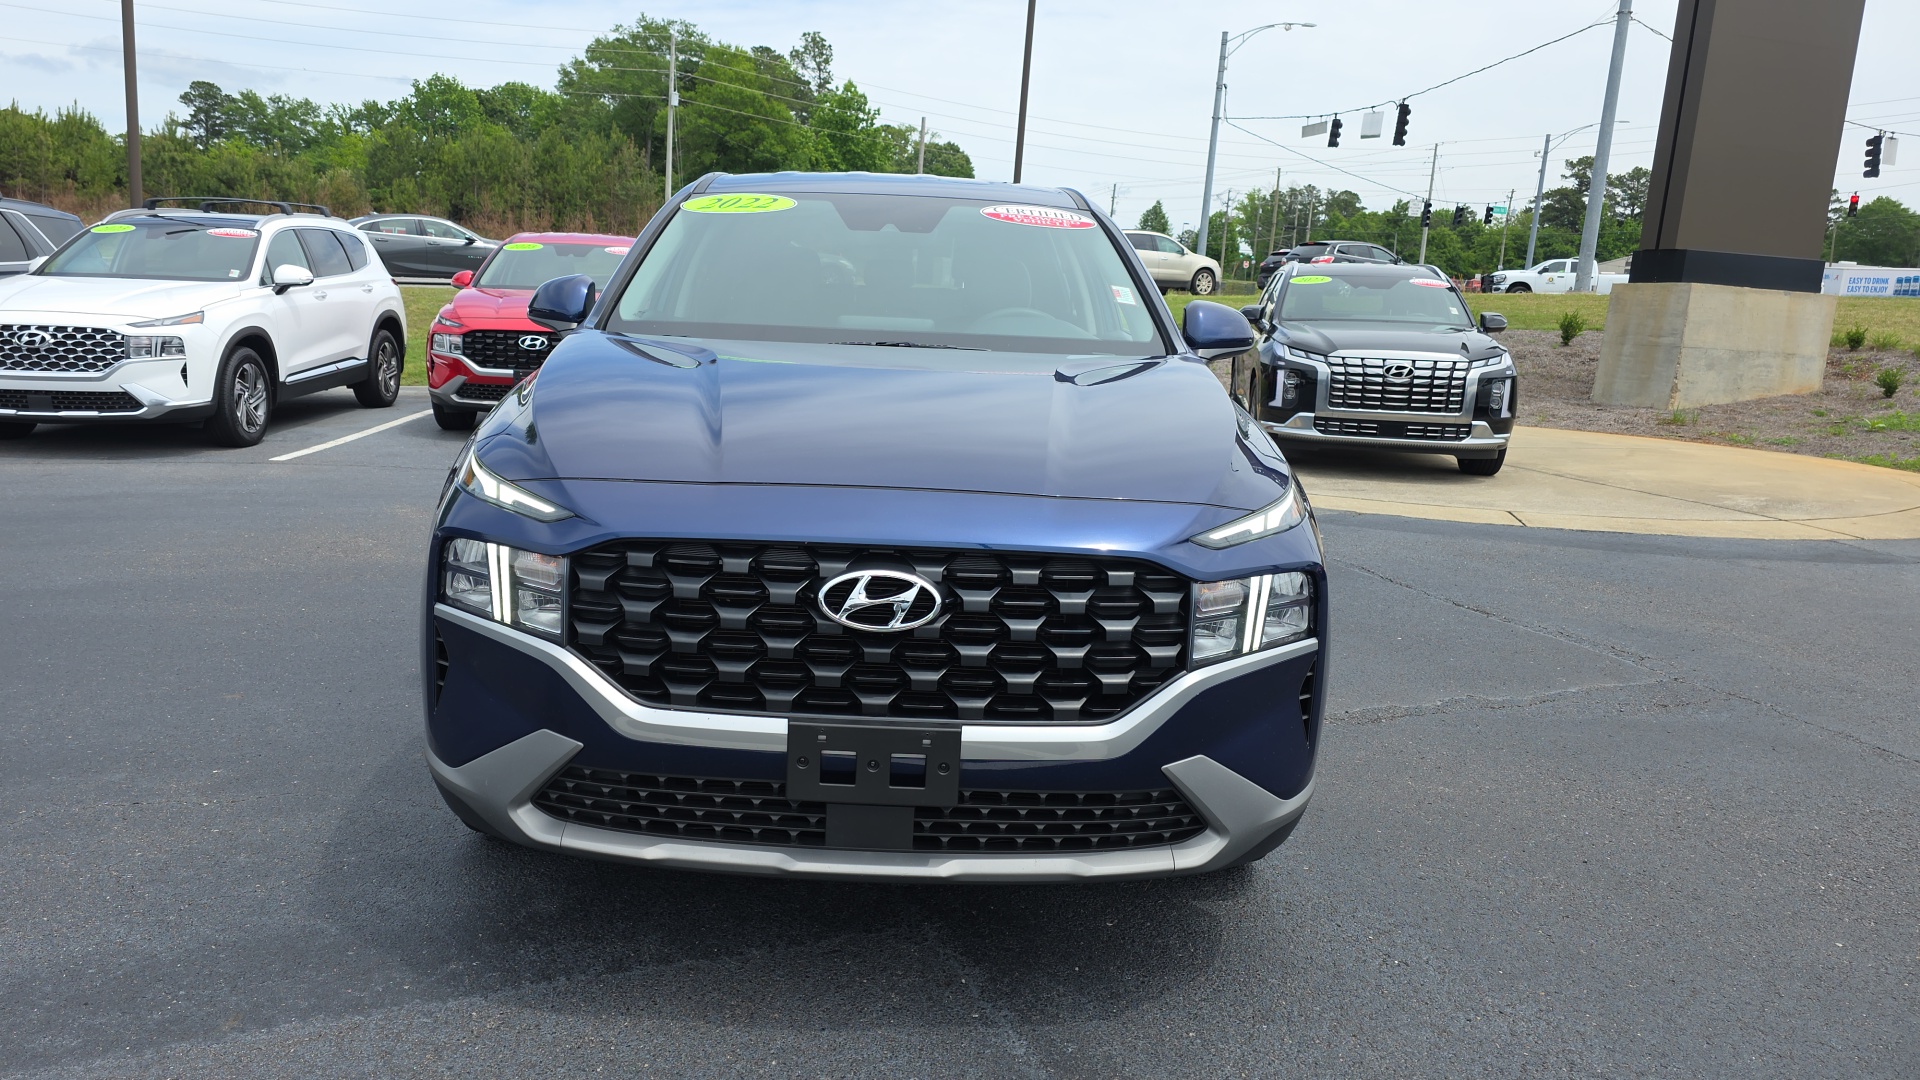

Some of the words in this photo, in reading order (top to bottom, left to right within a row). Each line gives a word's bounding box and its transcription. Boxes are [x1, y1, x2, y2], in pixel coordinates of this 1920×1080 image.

[696, 197, 779, 210] 2022
[993, 206, 1082, 221] CERTIFIED
[1000, 213, 1081, 225] PRE-OWNED
[1013, 216, 1071, 228] VEHICLE
[1848, 277, 1863, 285] EASY
[1864, 277, 1871, 285] TO
[1872, 277, 1890, 285] DRINK
[1846, 285, 1862, 293] EASY
[1862, 285, 1869, 293] TO
